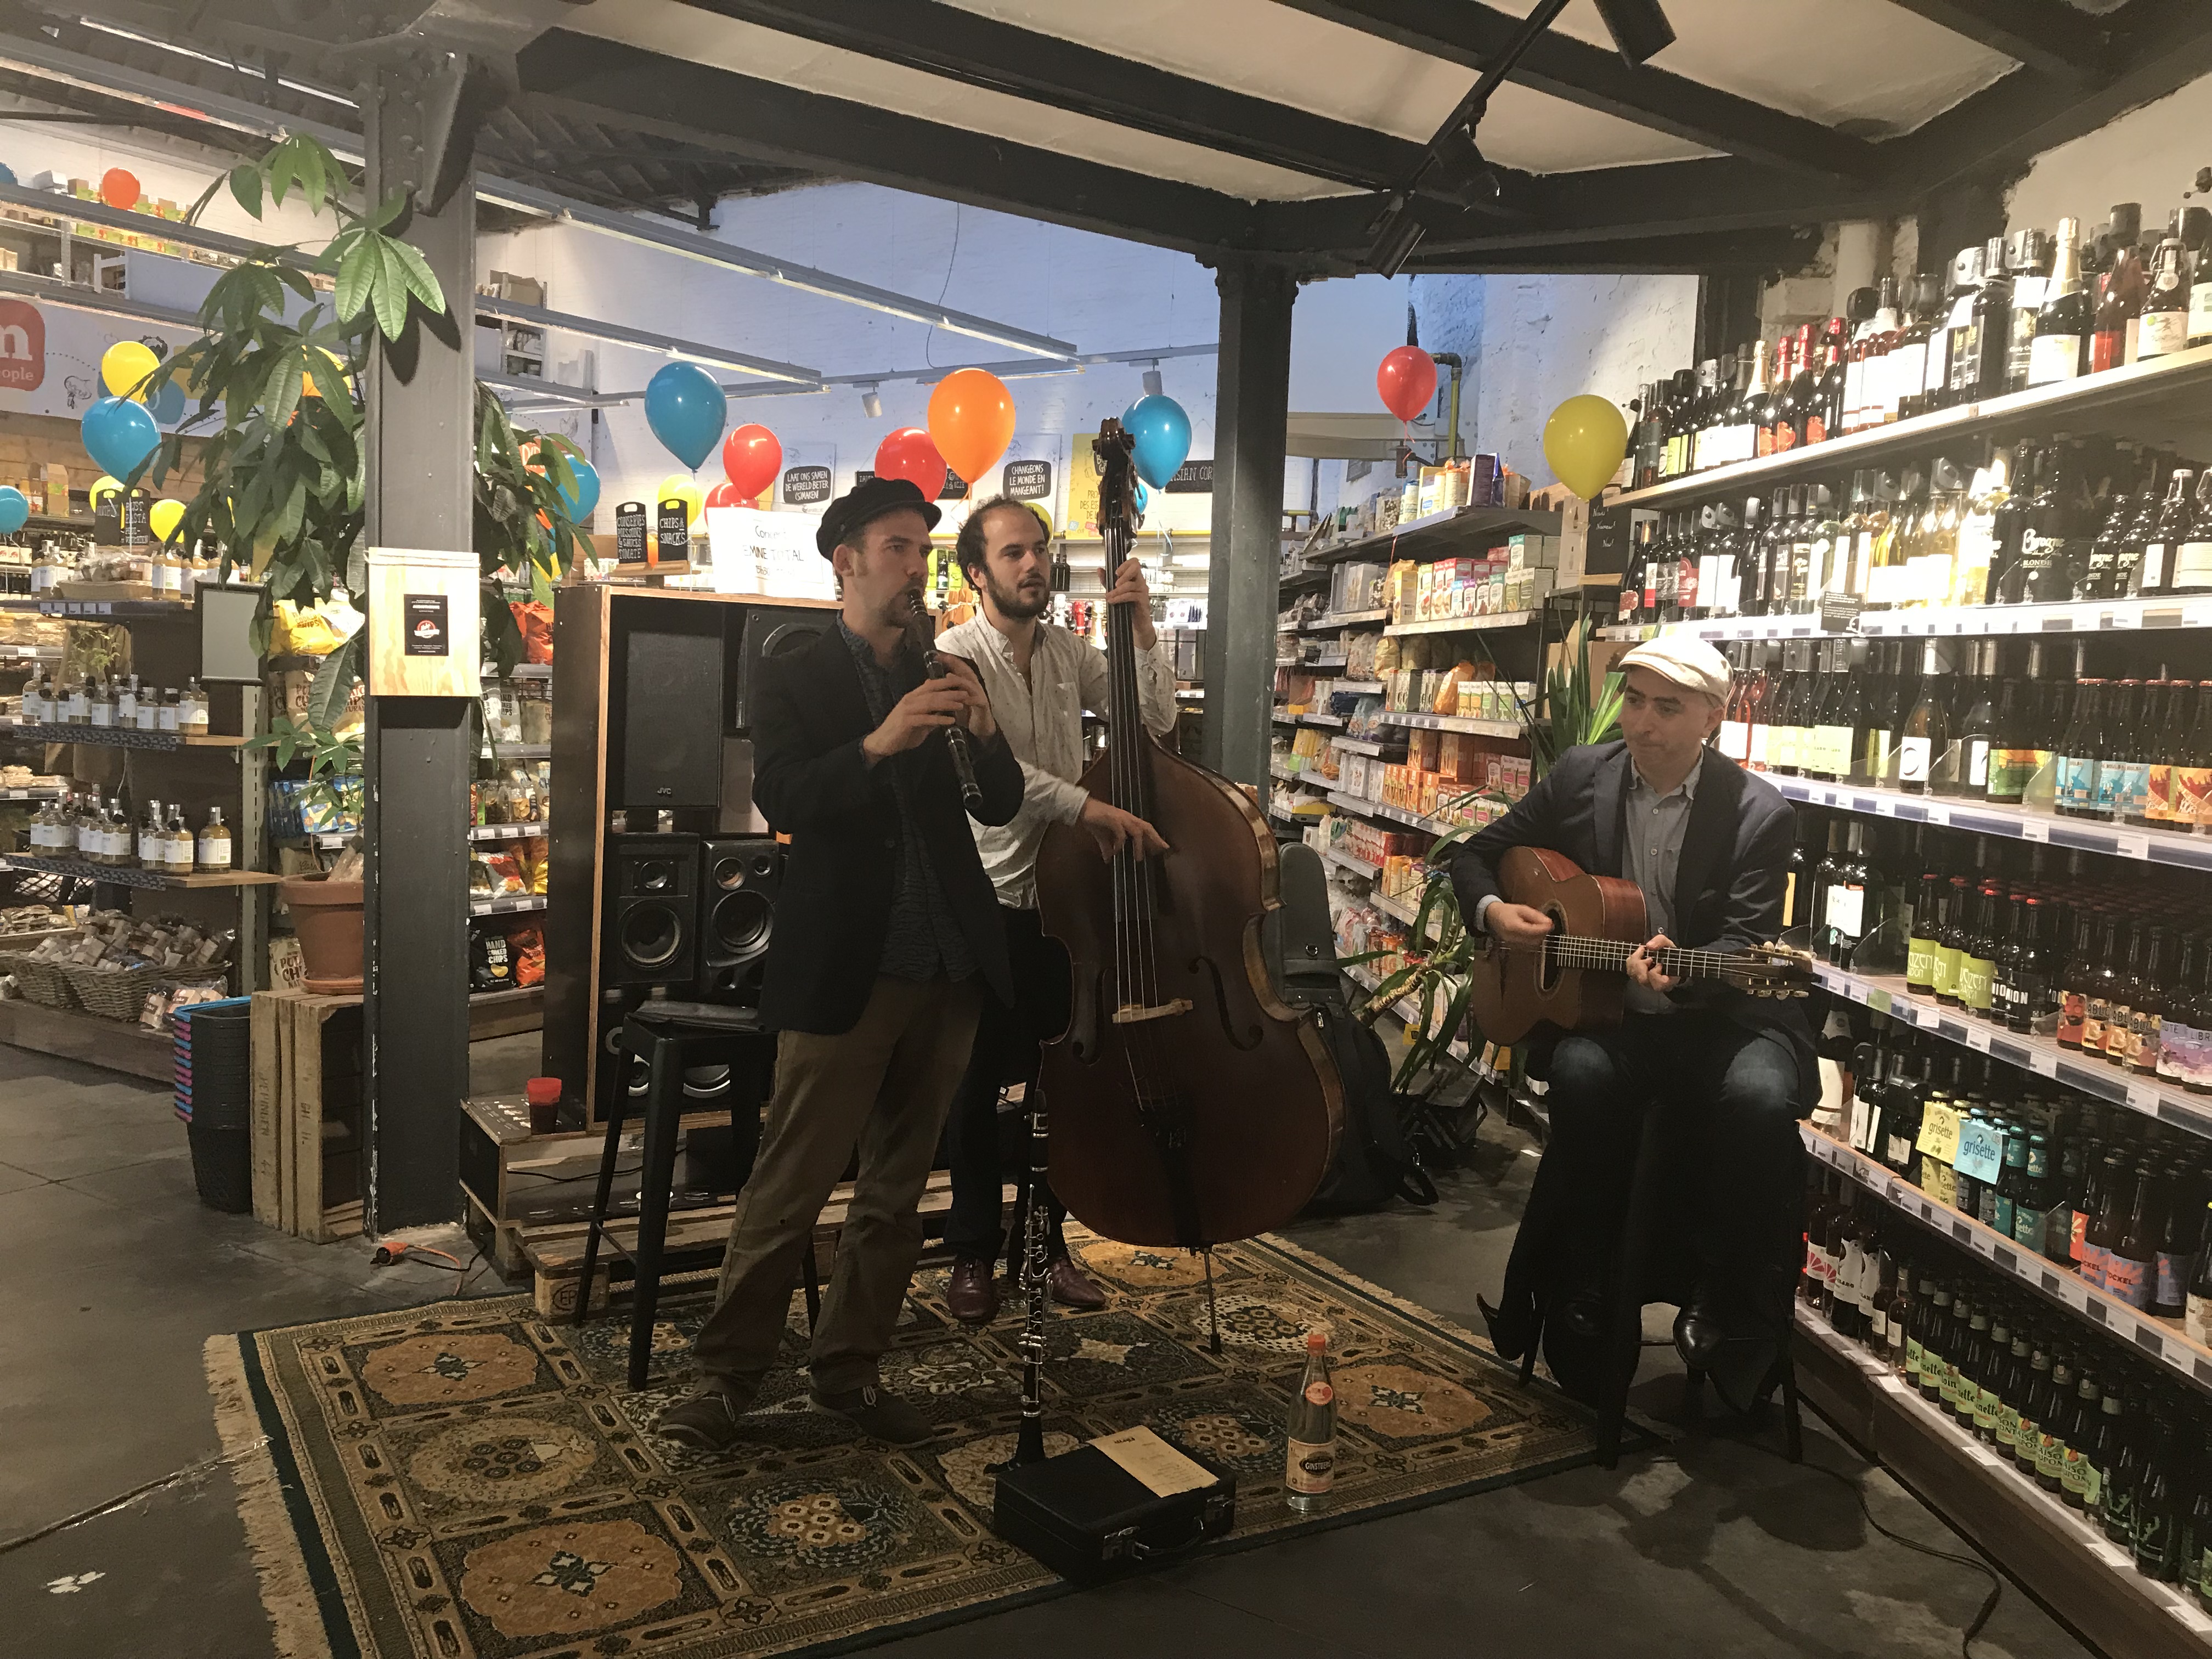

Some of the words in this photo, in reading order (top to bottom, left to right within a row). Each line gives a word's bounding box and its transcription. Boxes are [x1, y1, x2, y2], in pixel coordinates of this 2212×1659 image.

[1011, 464, 1044, 475] CHANGEONS
[787, 472, 800, 482] LAAT
[800, 472, 810, 481] ONS
[811, 470, 828, 481] SAMEN
[1009, 476, 1017, 486] LE
[1017, 475, 1037, 485] MONDE
[1037, 473, 1046, 483] EN
[785, 483, 792, 492] DE
[792, 481, 812, 492] WERELD
[812, 480, 829, 489] BETER
[1010, 484, 1045, 496] MANGEANT!
[1080, 500, 1090, 510] DES
[1086, 511, 1094, 520] DE
[659, 517, 679, 529] CHIPS
[660, 532, 686, 545] SNACKS
[2022, 528, 2065, 555] Brogne
[657, 787, 672, 795] JVC
[485, 939, 506, 950] HAND
[488, 955, 509, 964] CHIPS
[1928, 1122, 1953, 1140] grisette
[1962, 1141, 1996, 1161] grisette
